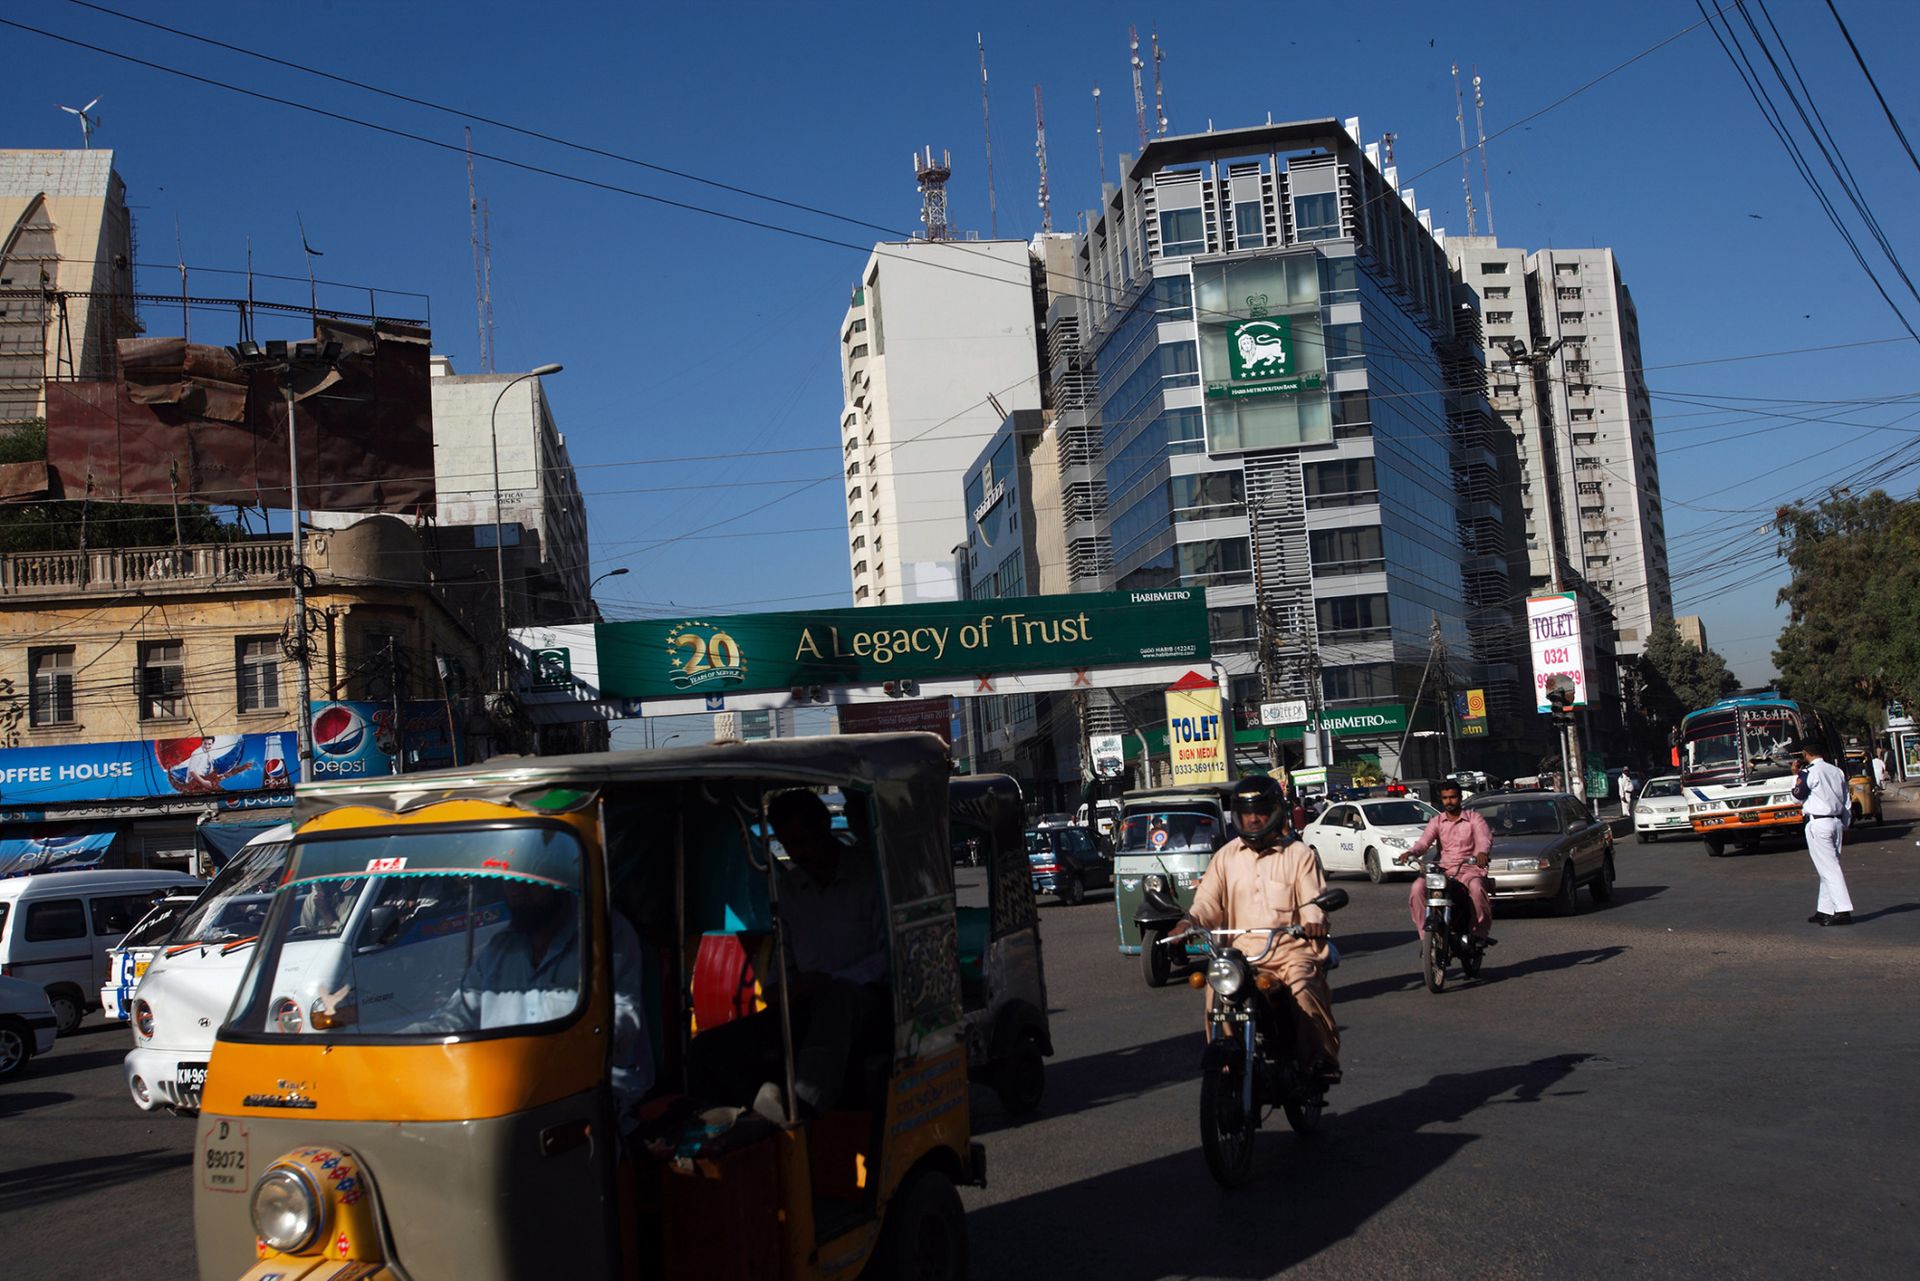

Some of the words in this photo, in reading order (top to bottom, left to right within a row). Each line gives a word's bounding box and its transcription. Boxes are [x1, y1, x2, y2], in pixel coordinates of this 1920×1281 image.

[1131, 591, 1191, 603] HABIBMETRO
[795, 627, 825, 661] A
[829, 625, 950, 664] Legacy
[959, 615, 995, 649] of
[1001, 611, 1094, 647] Trust
[674, 633, 740, 675] 20
[1544, 647, 1569, 665] 0321
[690, 674, 708, 684] YEARS
[707, 671, 716, 679] OF
[1743, 708, 1791, 721] ALLAH
[1462, 725, 1483, 735] atm
[1178, 748, 1195, 761] SIGN
[1196, 746, 1218, 760] MEDIA
[59, 761, 133, 780] HOUSE
[313, 758, 366, 776] pepsi
[219, 1121, 230, 1140] D
[206, 1149, 245, 1169] 89072
